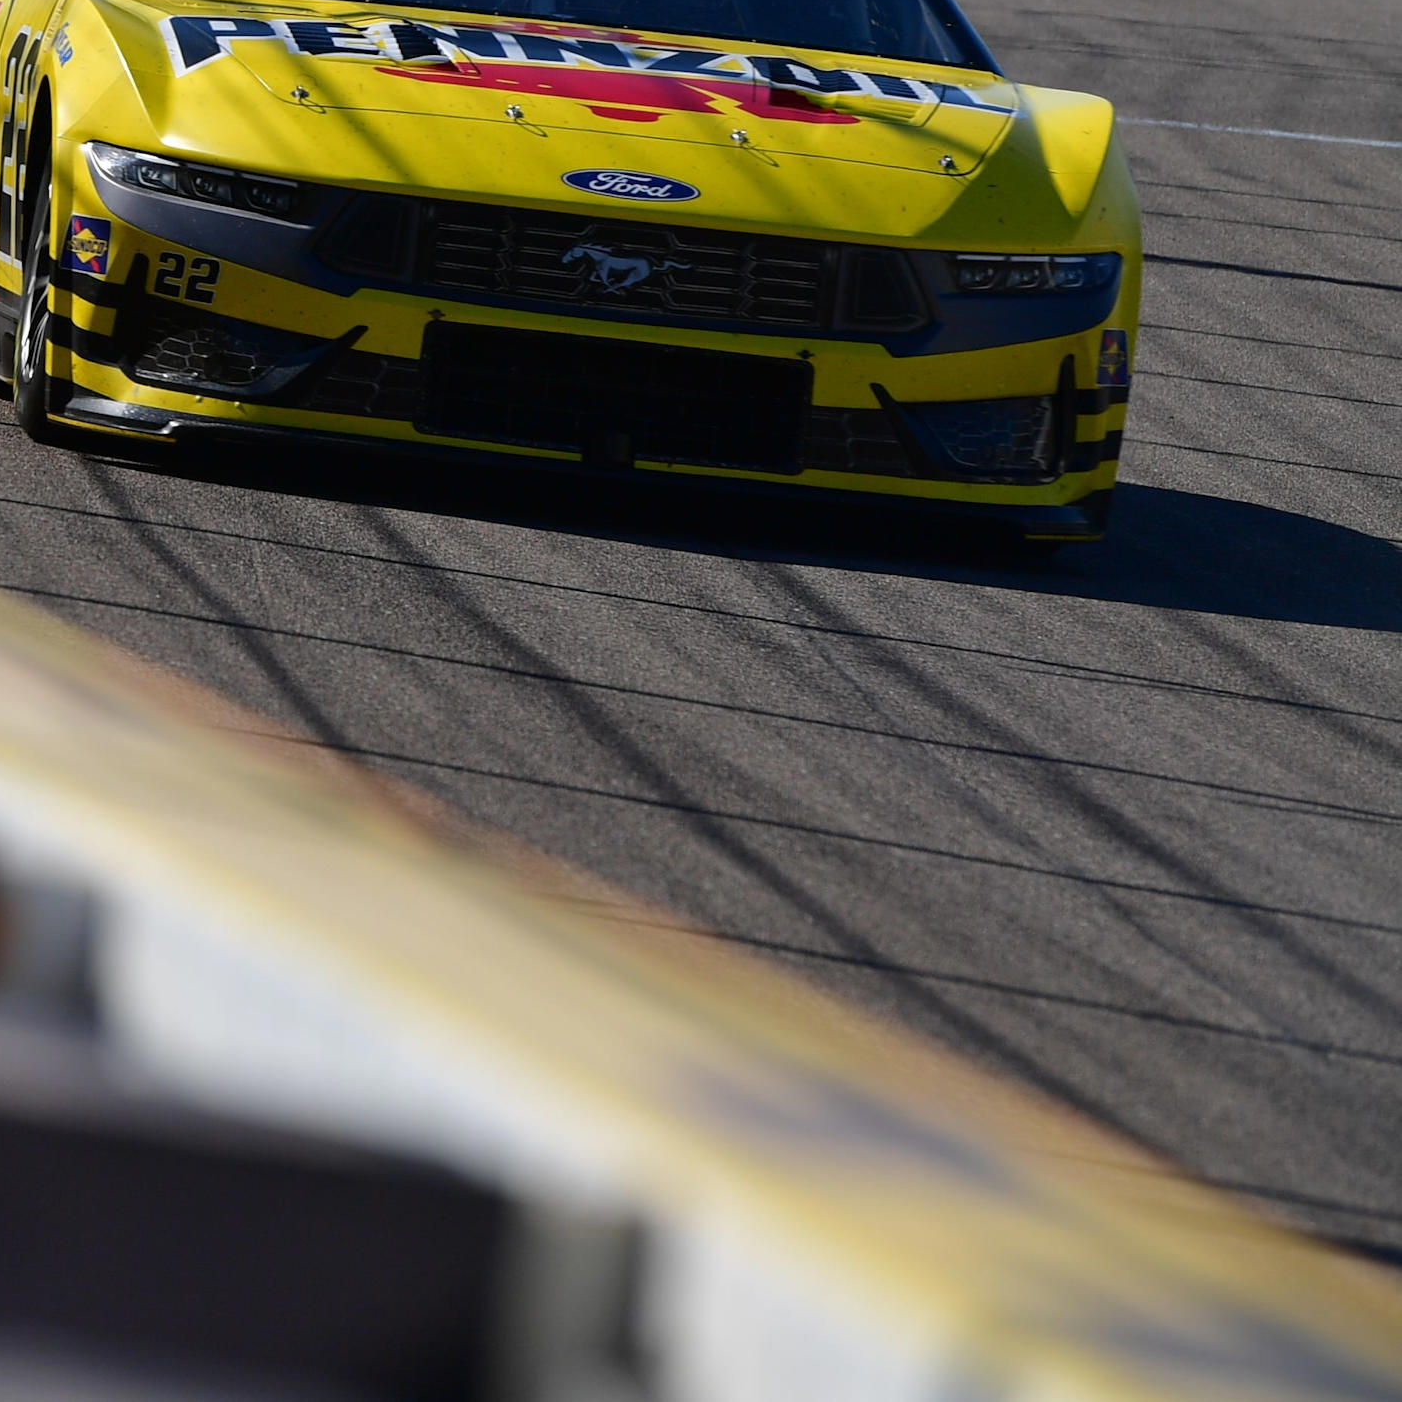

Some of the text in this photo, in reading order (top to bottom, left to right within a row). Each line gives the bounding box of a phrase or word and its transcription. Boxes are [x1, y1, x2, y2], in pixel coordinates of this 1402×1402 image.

[162, 14, 1016, 117] PENNZOIL
[588, 172, 672, 198] Ford
[153, 251, 221, 305] 22
